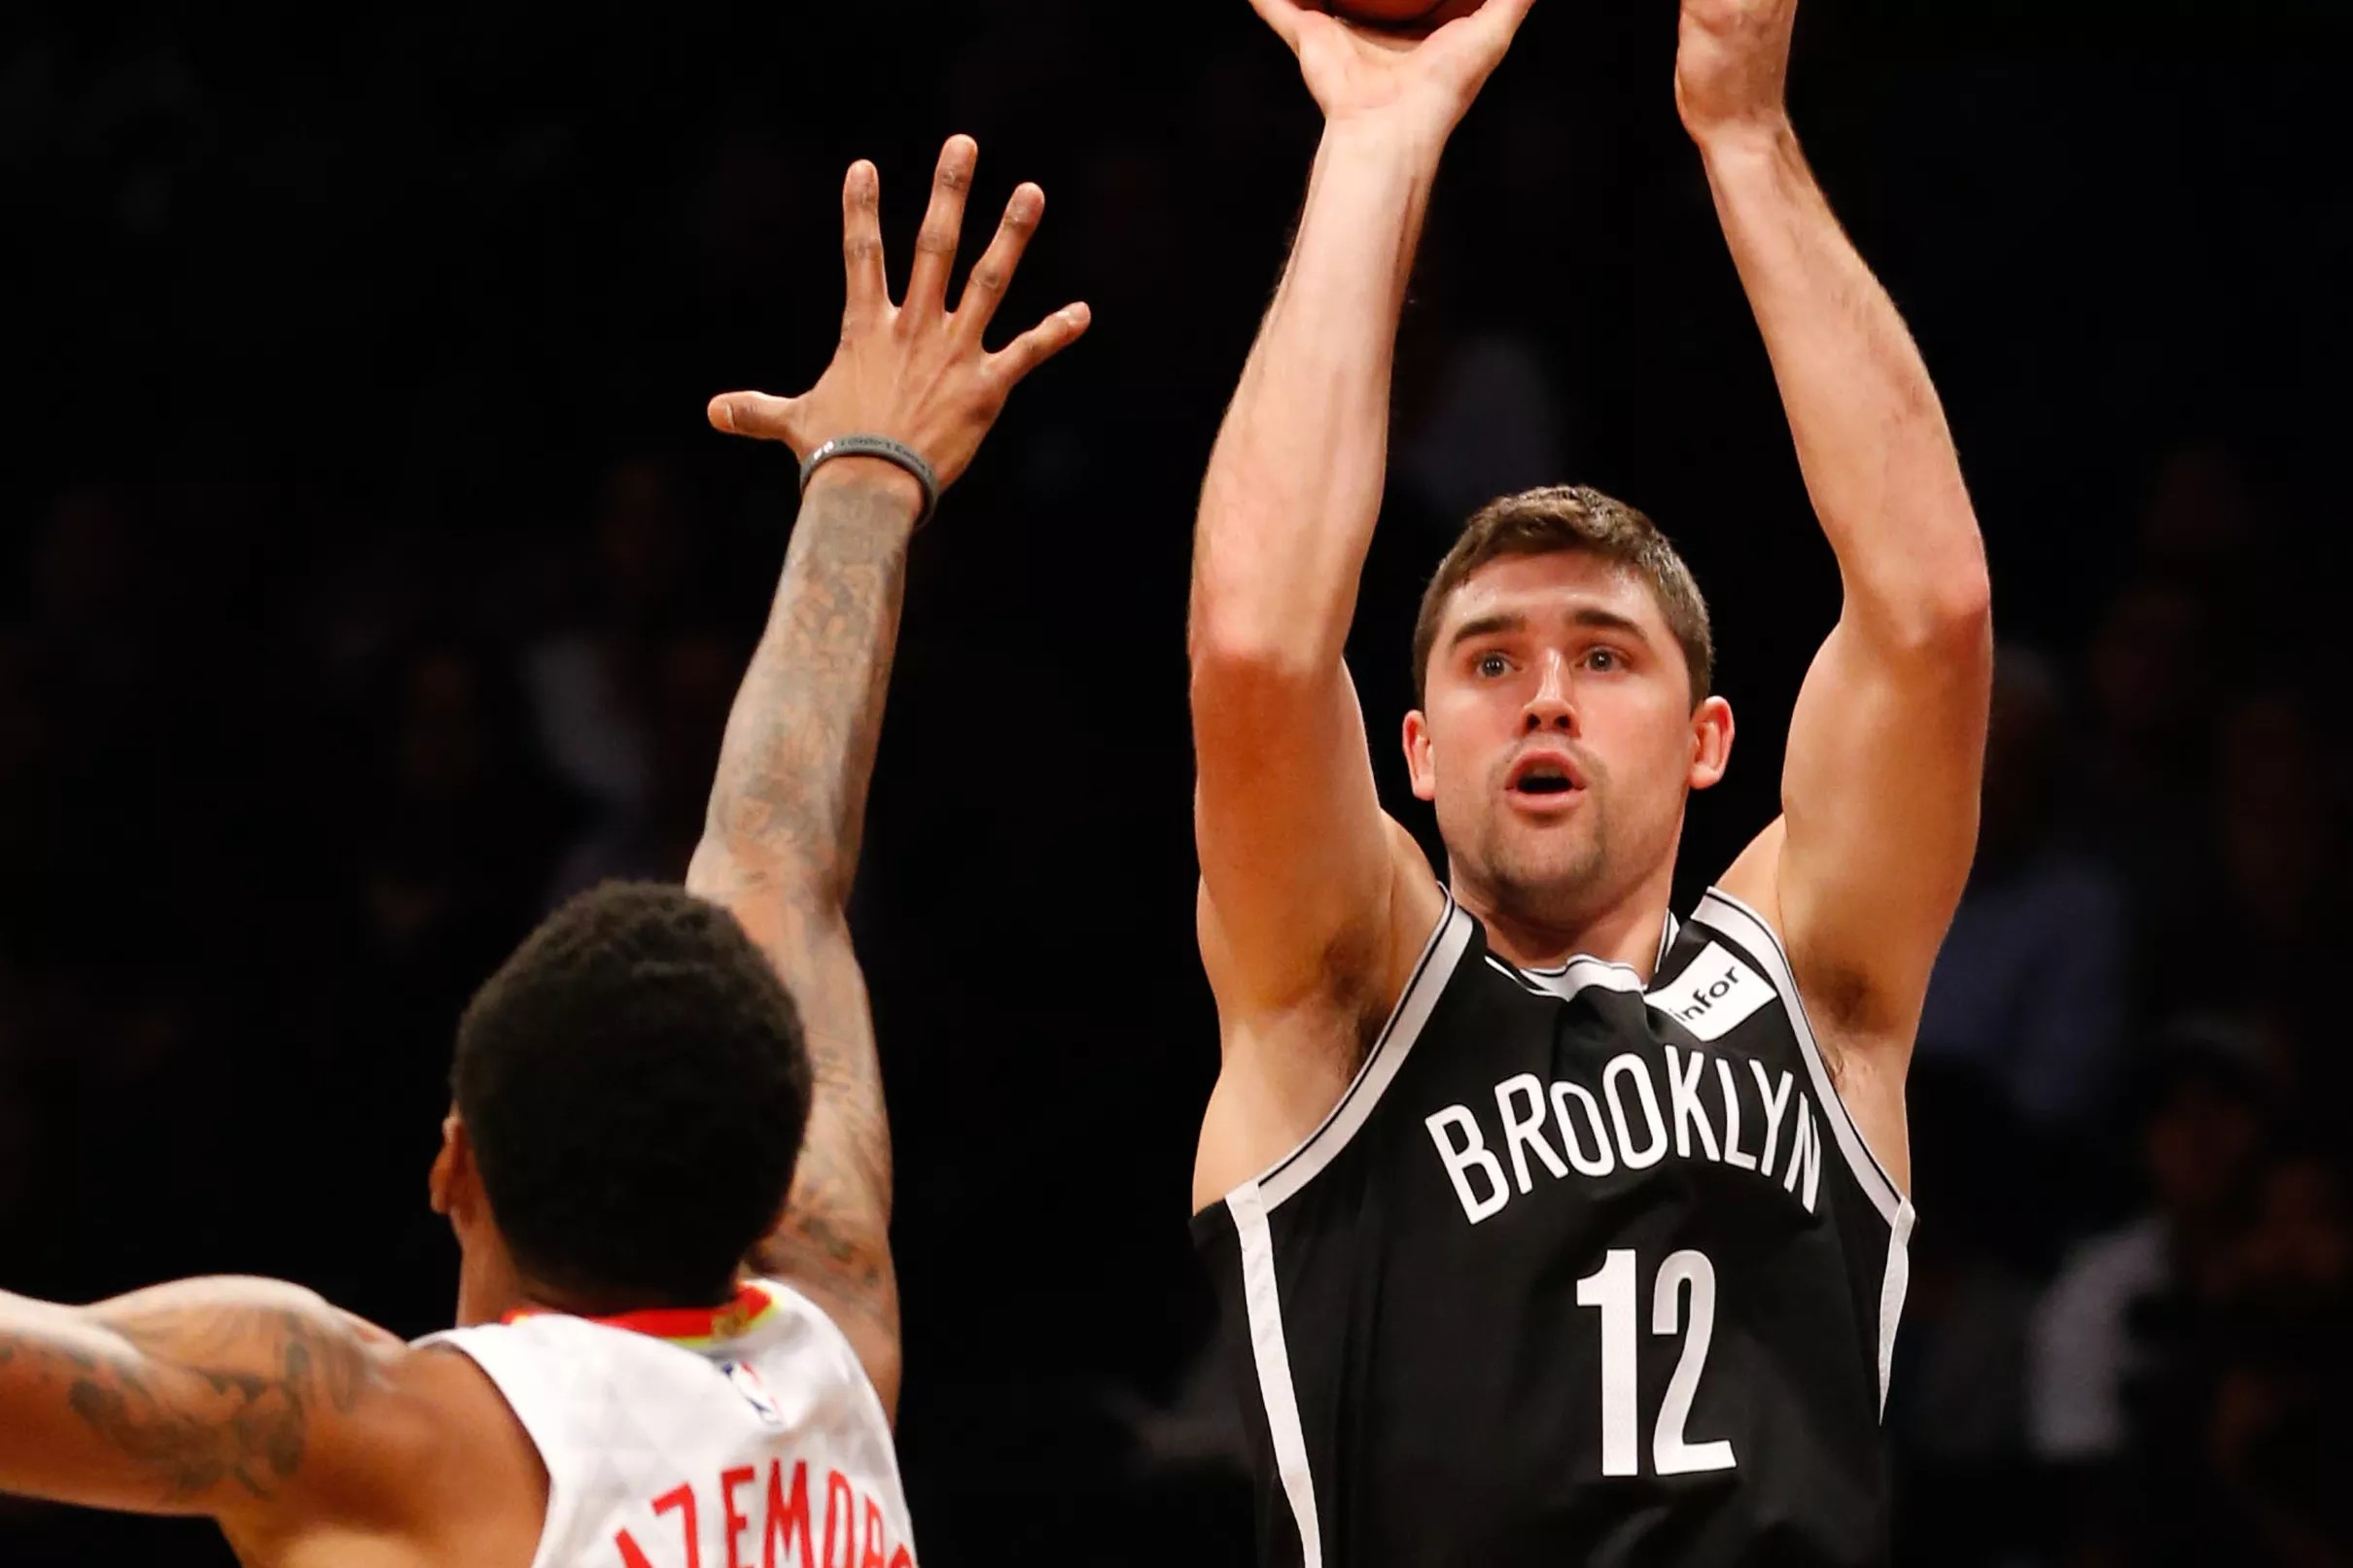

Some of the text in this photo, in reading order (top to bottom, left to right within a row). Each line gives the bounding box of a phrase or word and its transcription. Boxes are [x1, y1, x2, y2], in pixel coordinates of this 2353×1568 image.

[1668, 966, 1738, 1023] infor
[1424, 1045, 1821, 1225] BROOKLYN
[1576, 1248, 1738, 1477] 12
[615, 1458, 913, 1568] ZEMOR
